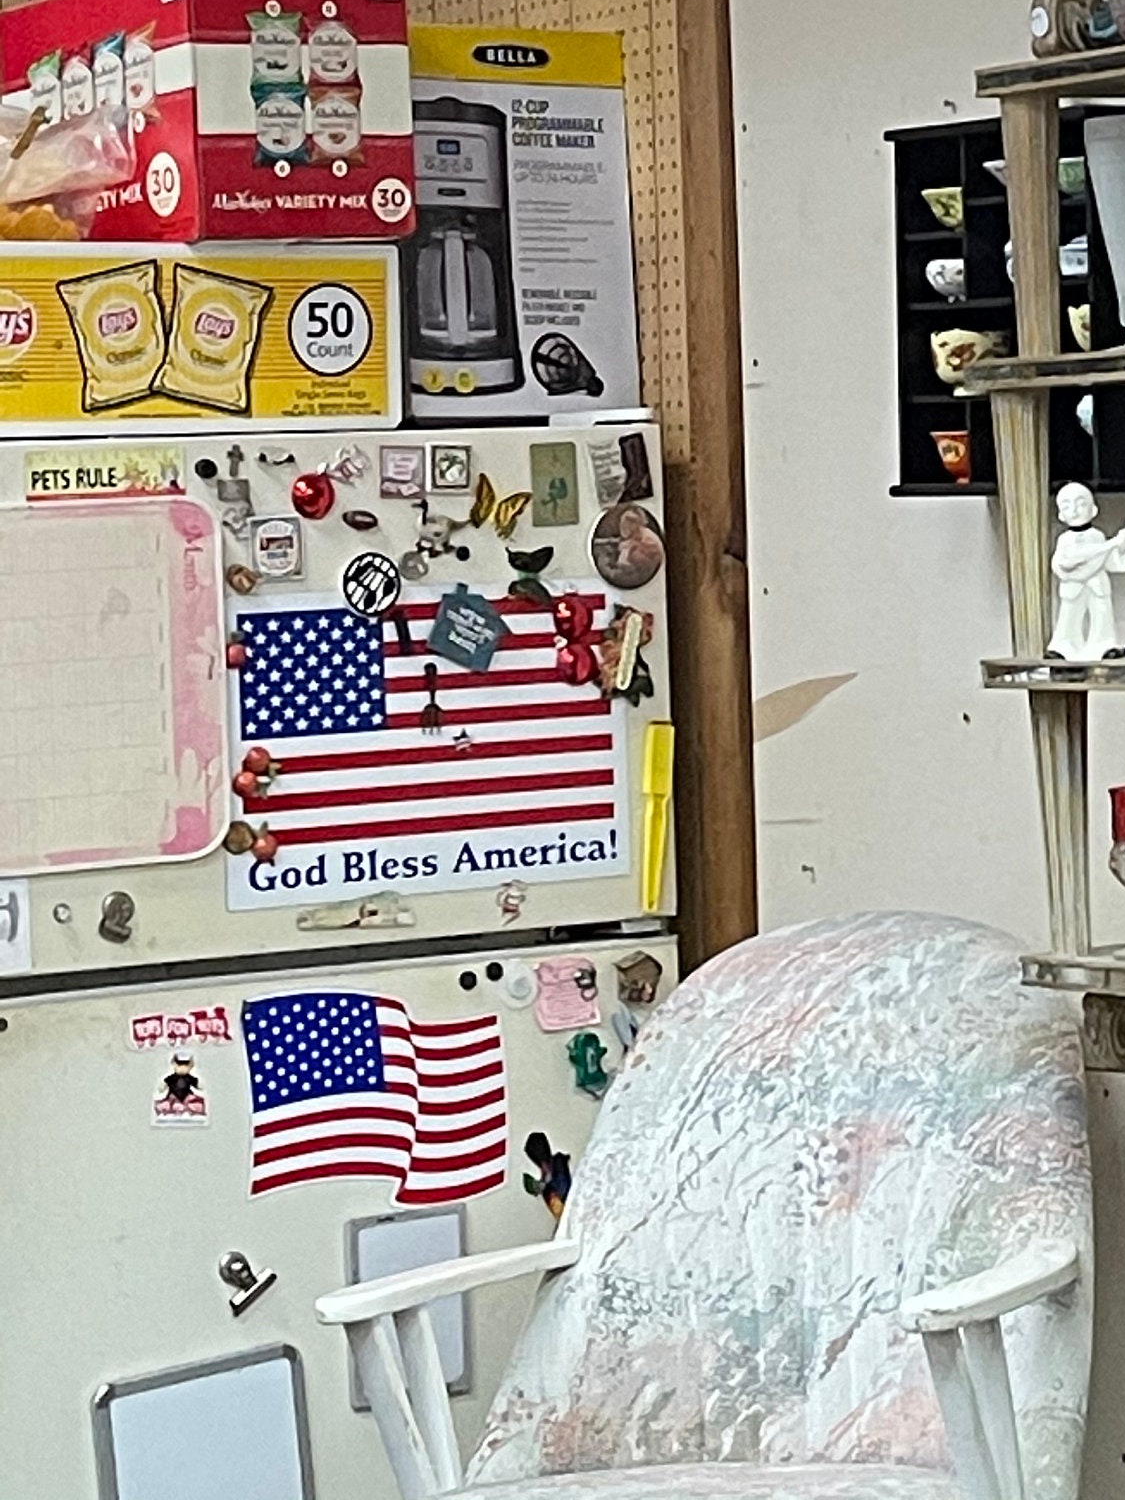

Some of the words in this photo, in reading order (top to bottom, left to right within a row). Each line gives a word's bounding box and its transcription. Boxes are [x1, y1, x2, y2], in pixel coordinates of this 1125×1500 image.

[485, 48, 538, 64] BELLA
[511, 132, 553, 147] COFFEE
[555, 134, 596, 149] MAKER
[152, 166, 175, 196] 30
[275, 193, 336, 209] VARIETY
[339, 193, 368, 209] MIX
[377, 188, 406, 208] 30
[306, 301, 354, 338] 50
[306, 341, 354, 358] Count
[31, 470, 70, 491] PETS
[75, 467, 118, 489] RULE
[249, 855, 327, 892] God
[342, 848, 438, 884] Bless
[453, 829, 618, 874] America!
